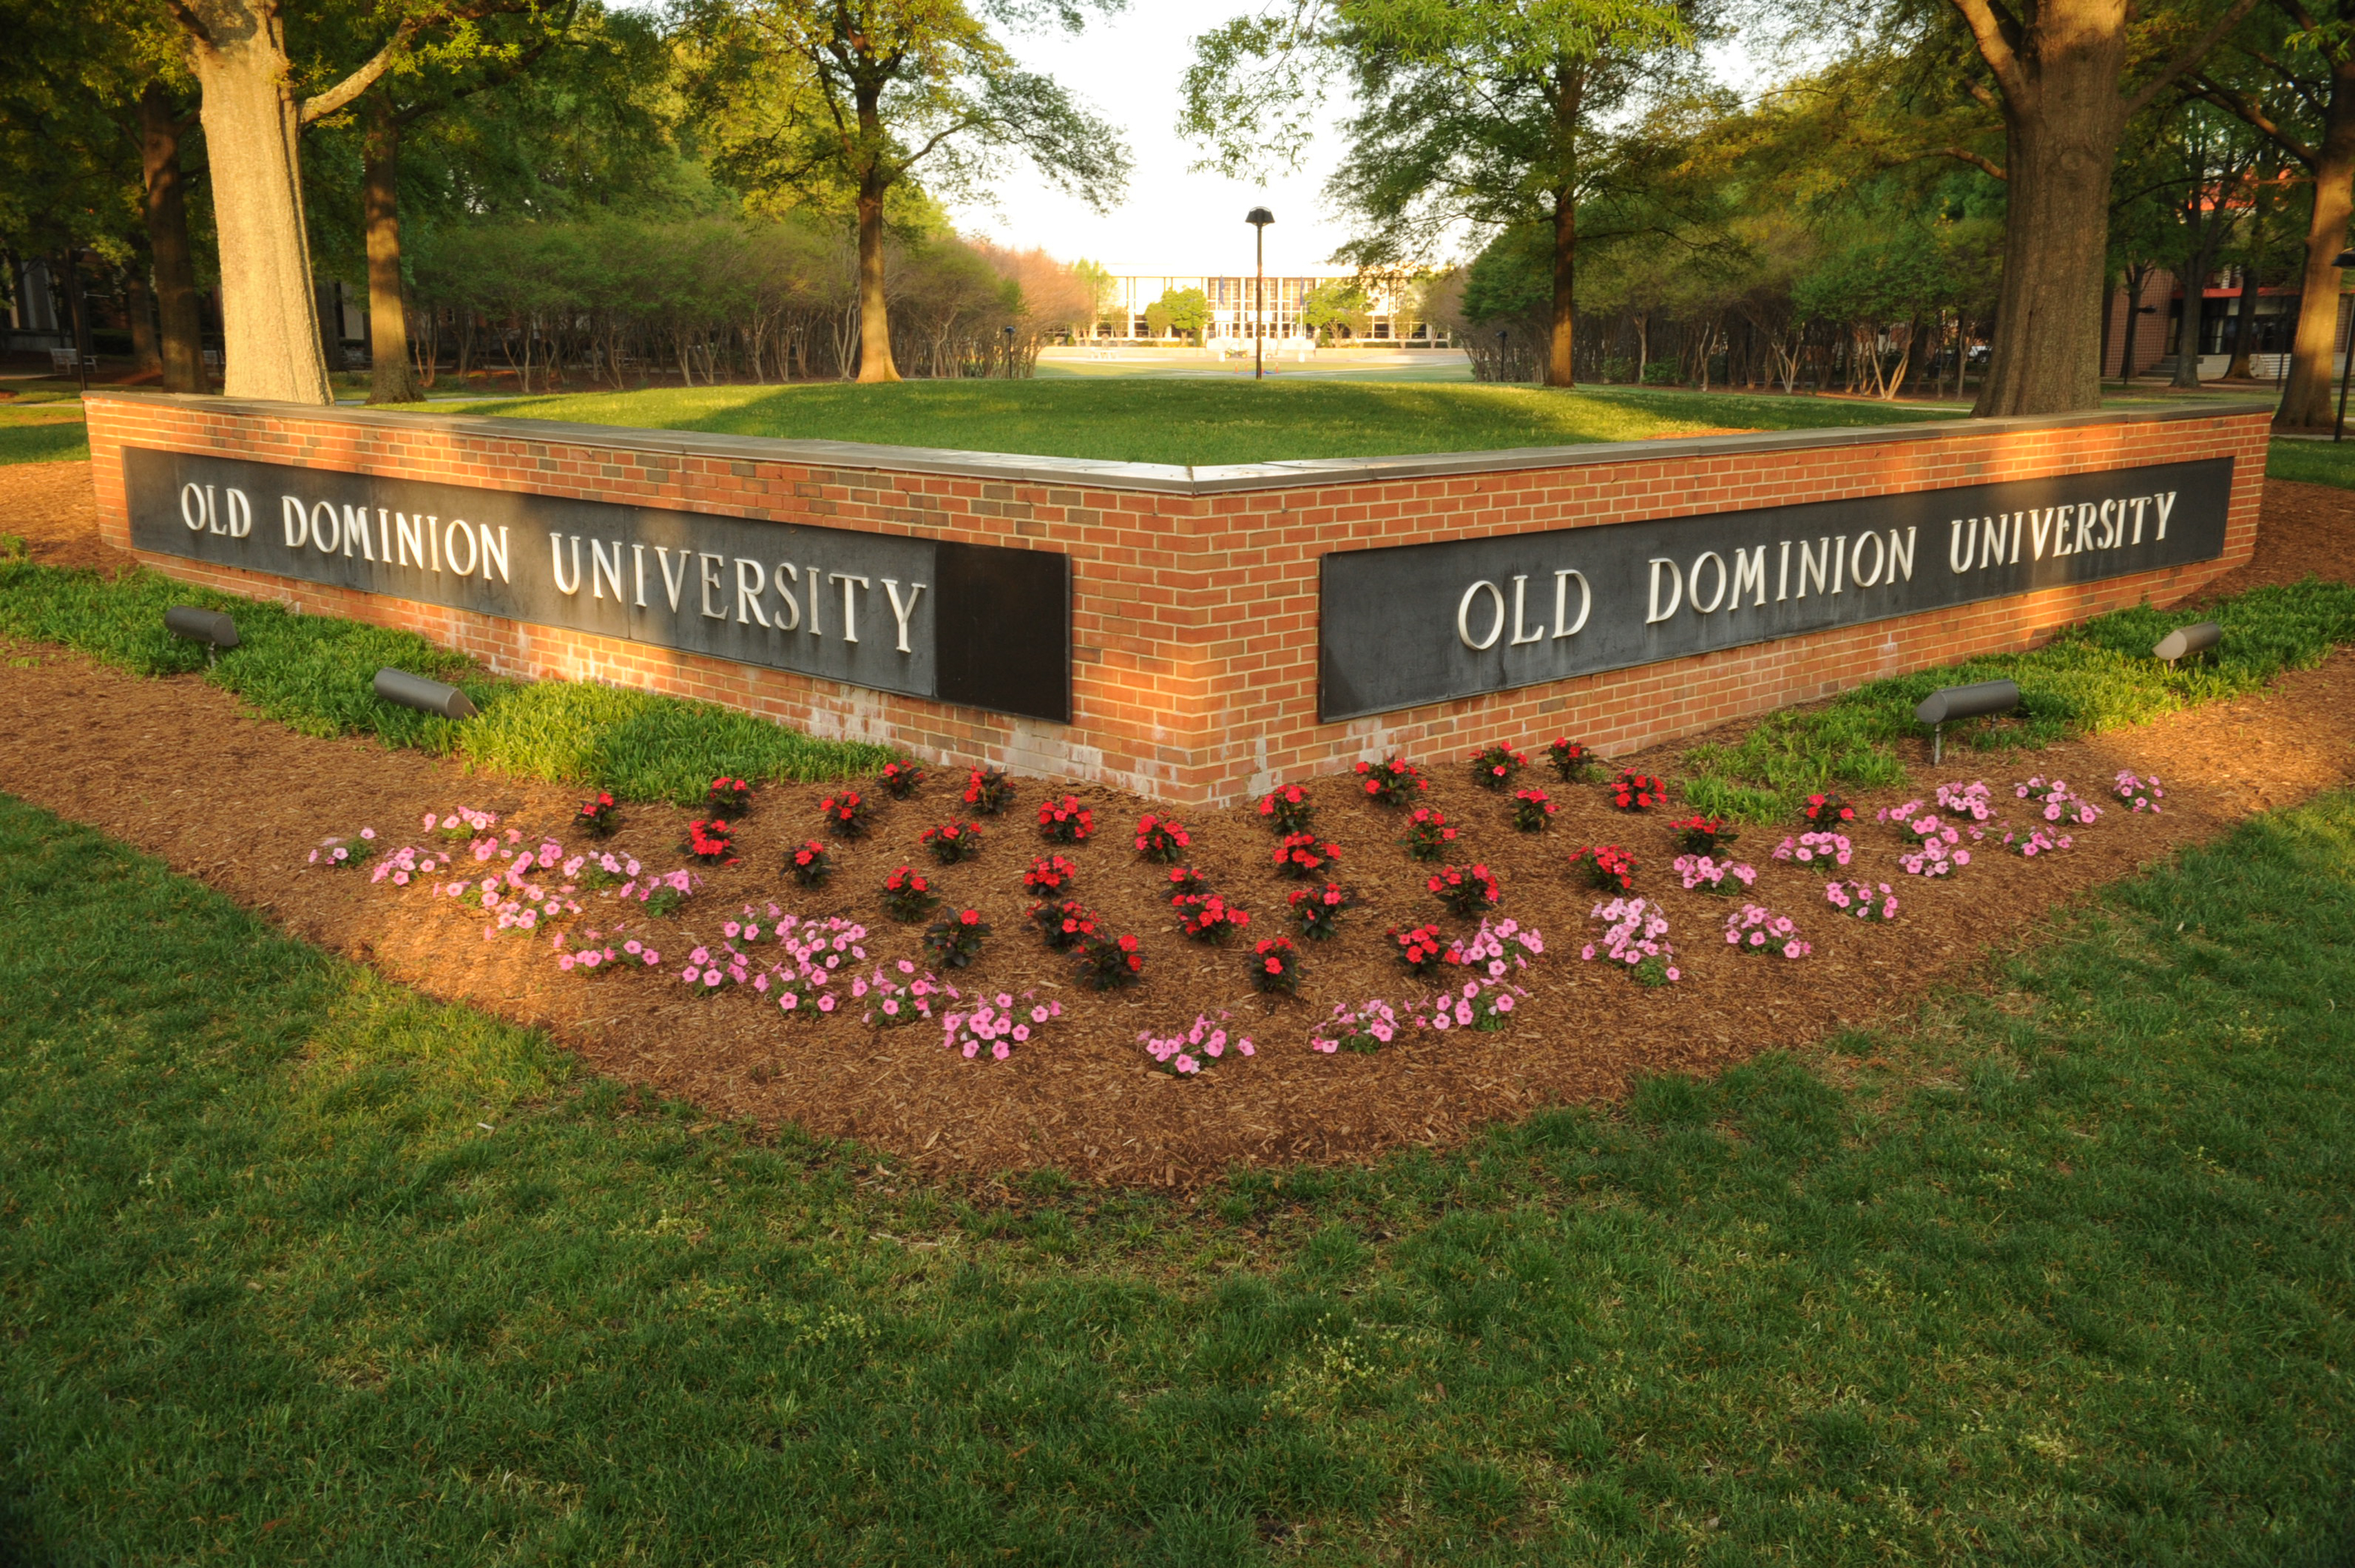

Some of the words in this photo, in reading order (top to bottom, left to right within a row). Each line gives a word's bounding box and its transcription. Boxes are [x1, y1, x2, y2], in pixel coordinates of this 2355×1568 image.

[181, 482, 252, 539] OLD
[281, 494, 509, 585] DOMINION
[548, 532, 927, 654] UNIVERSITY
[1457, 569, 1591, 651] OLD
[1646, 525, 1917, 625] DOMINION
[1949, 491, 2178, 575] UNIVERSITY
